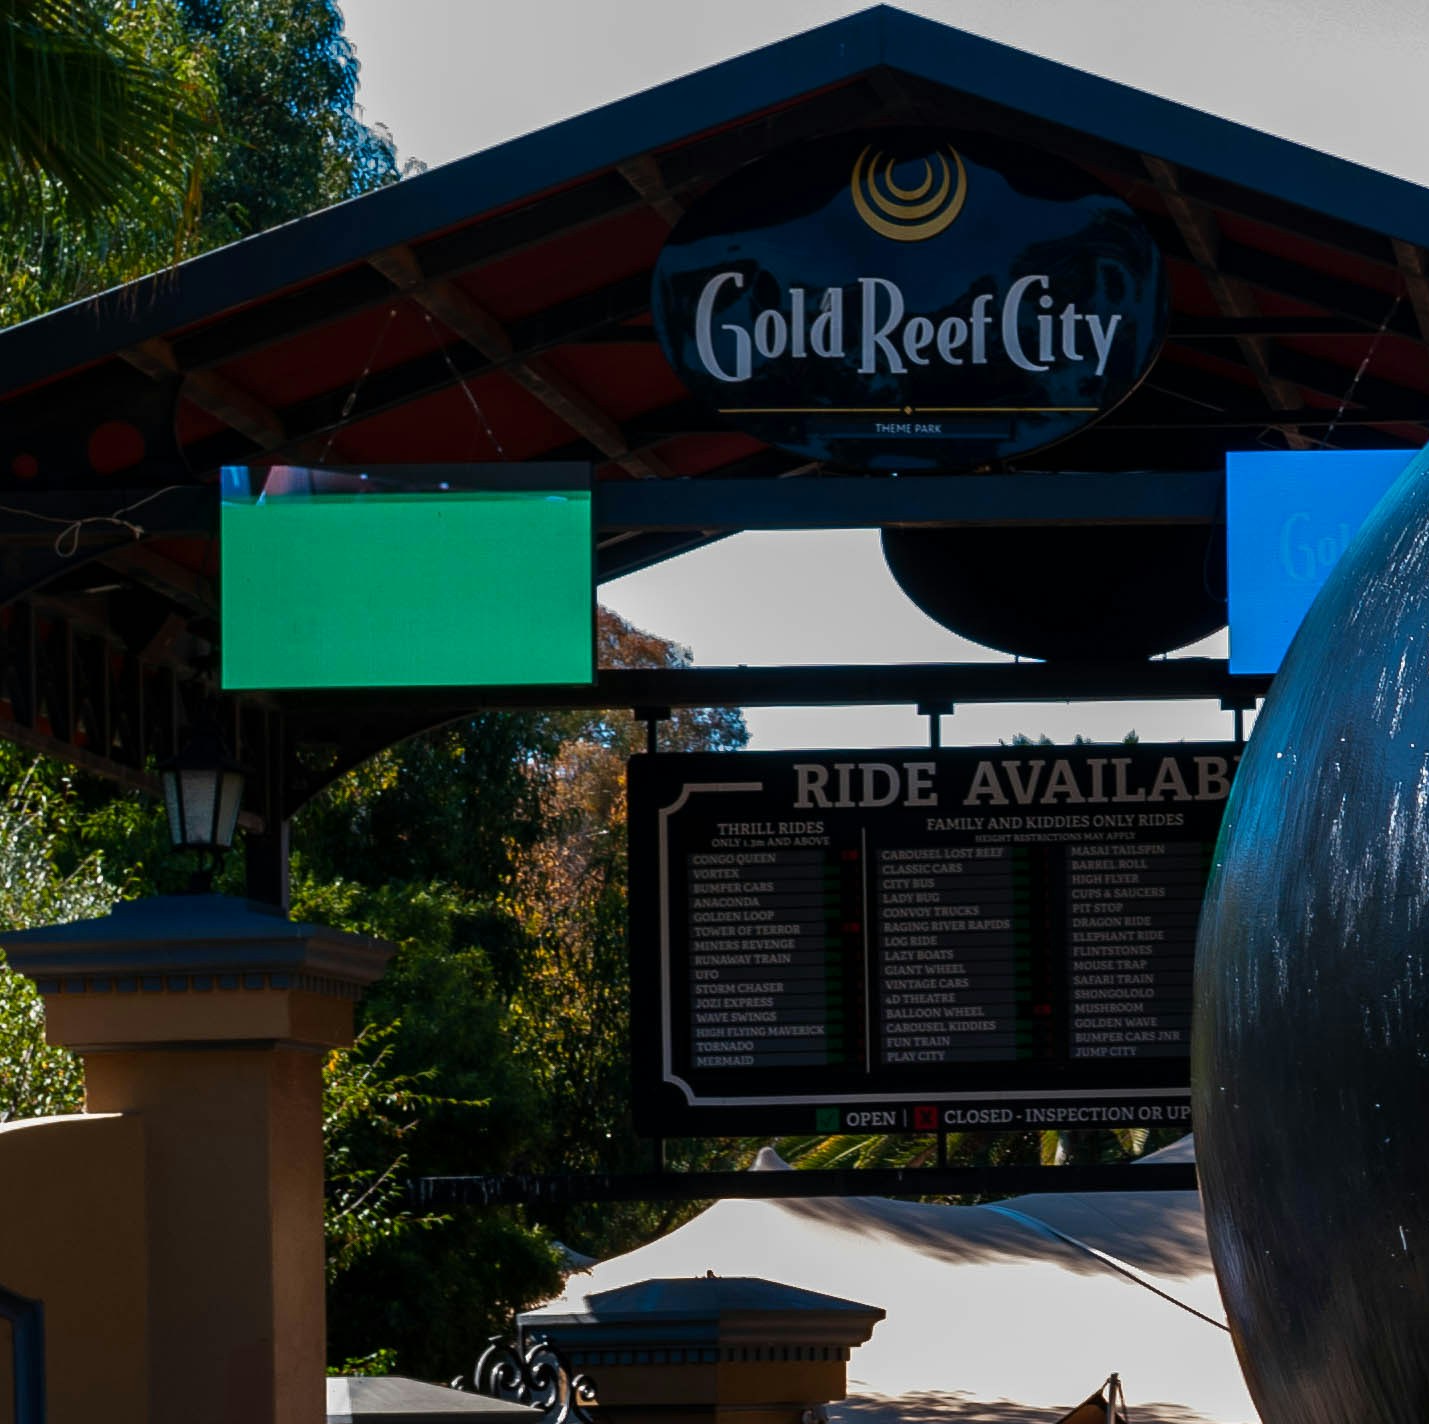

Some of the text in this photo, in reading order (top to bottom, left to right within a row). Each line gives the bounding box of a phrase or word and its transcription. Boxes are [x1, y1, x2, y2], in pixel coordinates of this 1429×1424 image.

[695, 271, 1122, 383] Gold Reef City
[875, 423, 942, 433] THEME PARK
[793, 755, 1240, 808] RIDE AVAILAB
[926, 813, 1184, 831] FAMILY AND KIDDIES ONLY RIDES
[717, 821, 824, 836] THRILL RIDES
[711, 839, 741, 847] ONLY
[768, 838, 792, 846] AND
[793, 837, 830, 846] ABOVE
[975, 834, 1011, 842] HEIGHT
[1014, 832, 1082, 842] RESTRICTIONS
[1084, 832, 1103, 840] MAY
[882, 848, 1003, 860] CAROUSEL LOST REEF
[1112, 845, 1165, 854] TAILSPIN
[693, 853, 776, 864] CONGO QUEEN
[882, 863, 962, 874] CLASSIC CARS
[1072, 860, 1147, 869] BARREL ROLL
[693, 869, 739, 878] VORTEX
[1072, 874, 1139, 884] HIGH FLYER
[693, 882, 774, 893] BUMPER CARS
[883, 879, 935, 888] CITY BUS
[883, 893, 940, 903] LADY BUG
[1072, 889, 1101, 898] CUPS
[1114, 888, 1165, 897] SAUCERS
[694, 897, 760, 908] ANACONDA
[1072, 903, 1123, 913] PIT STOP
[694, 911, 775, 922] GOLDEN LOOP
[883, 906, 980, 918] CONVOY TRUCKS
[884, 920, 1010, 932] RAGING RIVER RAPIDS
[1072, 916, 1151, 927] DRAGON RIDE
[695, 924, 800, 937] TOWER OF TERROR
[1073, 931, 1164, 941] ELEPHANT RIDE
[695, 939, 795, 951] MINERS REVENGE
[885, 936, 937, 946] LOG RIDE
[885, 950, 954, 960] LAZY BOATS
[1073, 946, 1152, 956] FLINTSTONES
[695, 953, 791, 965] RUNAWAY TRAIN
[885, 964, 967, 975] GIANT WHEEL
[1073, 960, 1147, 970] MOUSE TRAP
[695, 970, 719, 980] UFO
[1073, 974, 1154, 985] SAFARI TRAIN
[696, 982, 784, 995] STORM CHASER
[885, 978, 969, 989] VINTAGE CARS
[903, 993, 956, 1002] THEATRE
[1074, 989, 1154, 999] SHONGOLOLO
[696, 997, 774, 1009] JOZI EXPRESS
[1075, 1003, 1144, 1013] MUSHROOM
[696, 1011, 777, 1023] WAVE SWINGS
[886, 1007, 984, 1018] BALLOON WHEEL
[886, 1021, 996, 1032] CAROUSEL KIDDIES
[1074, 1017, 1158, 1028] GOLDEN WAVE
[696, 1025, 824, 1038] HIGH FLYING MAVERICK
[1075, 1031, 1181, 1042] BUMPER CARS JNR
[696, 1041, 754, 1051] TORNADO
[887, 1036, 950, 1047] FUN TRAIN
[887, 1051, 945, 1062] PLAY CITY
[1075, 1046, 1136, 1057] JUMP CITY
[697, 1056, 754, 1066] MERMAID
[846, 1111, 896, 1127] OPEN
[944, 1109, 1014, 1125] CLOSED
[1025, 1106, 1135, 1123] INSPECTION
[1138, 1106, 1163, 1120] OR
